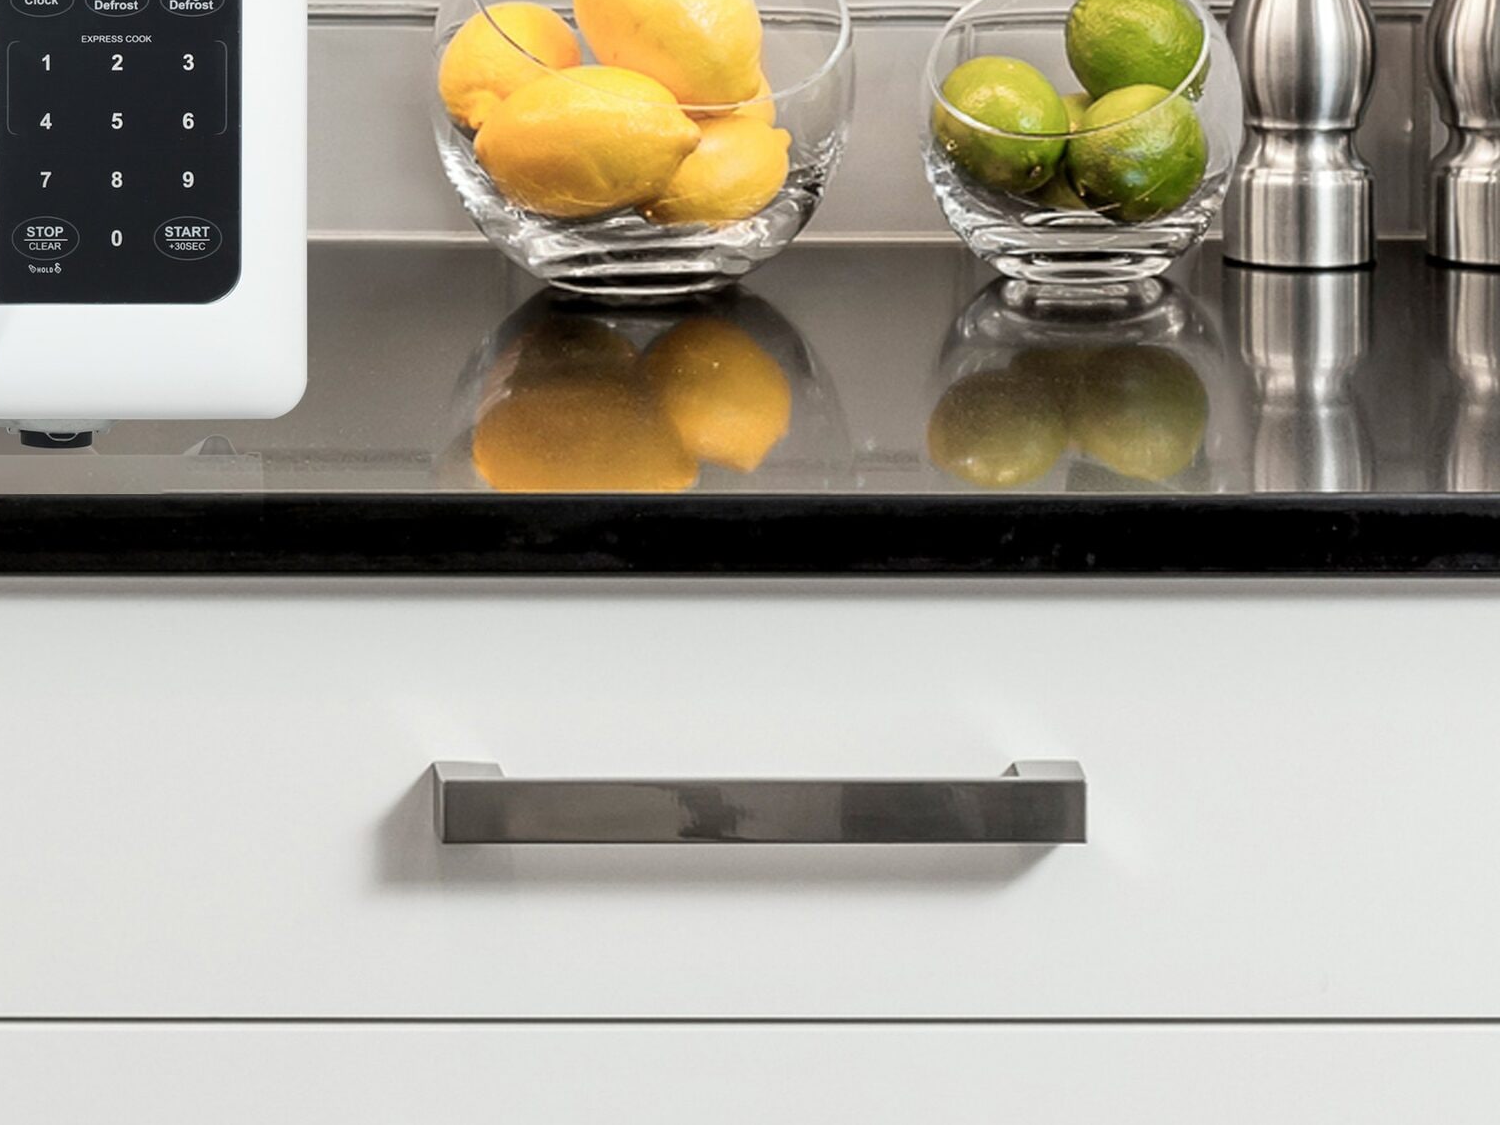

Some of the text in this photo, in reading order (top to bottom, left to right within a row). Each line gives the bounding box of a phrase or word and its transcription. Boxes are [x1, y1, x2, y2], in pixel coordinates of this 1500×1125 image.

[94, 0, 139, 11] Defrost
[169, 0, 214, 10] Defrost
[81, 34, 153, 44] EXPRESS COOK
[41, 53, 51, 71] 1
[111, 53, 124, 71] 2
[182, 53, 195, 71] 3
[39, 112, 53, 130] 4
[111, 112, 124, 130] 5
[182, 112, 195, 130] 6
[40, 171, 52, 188] 7
[111, 171, 123, 189] 8
[182, 170, 195, 189] 9
[26, 225, 64, 238] STOP
[111, 229, 123, 247] 0
[164, 225, 211, 238] START
[28, 241, 62, 251] CLEAR
[169, 241, 206, 251] +30SEC
[36, 266, 54, 274] HOLD
